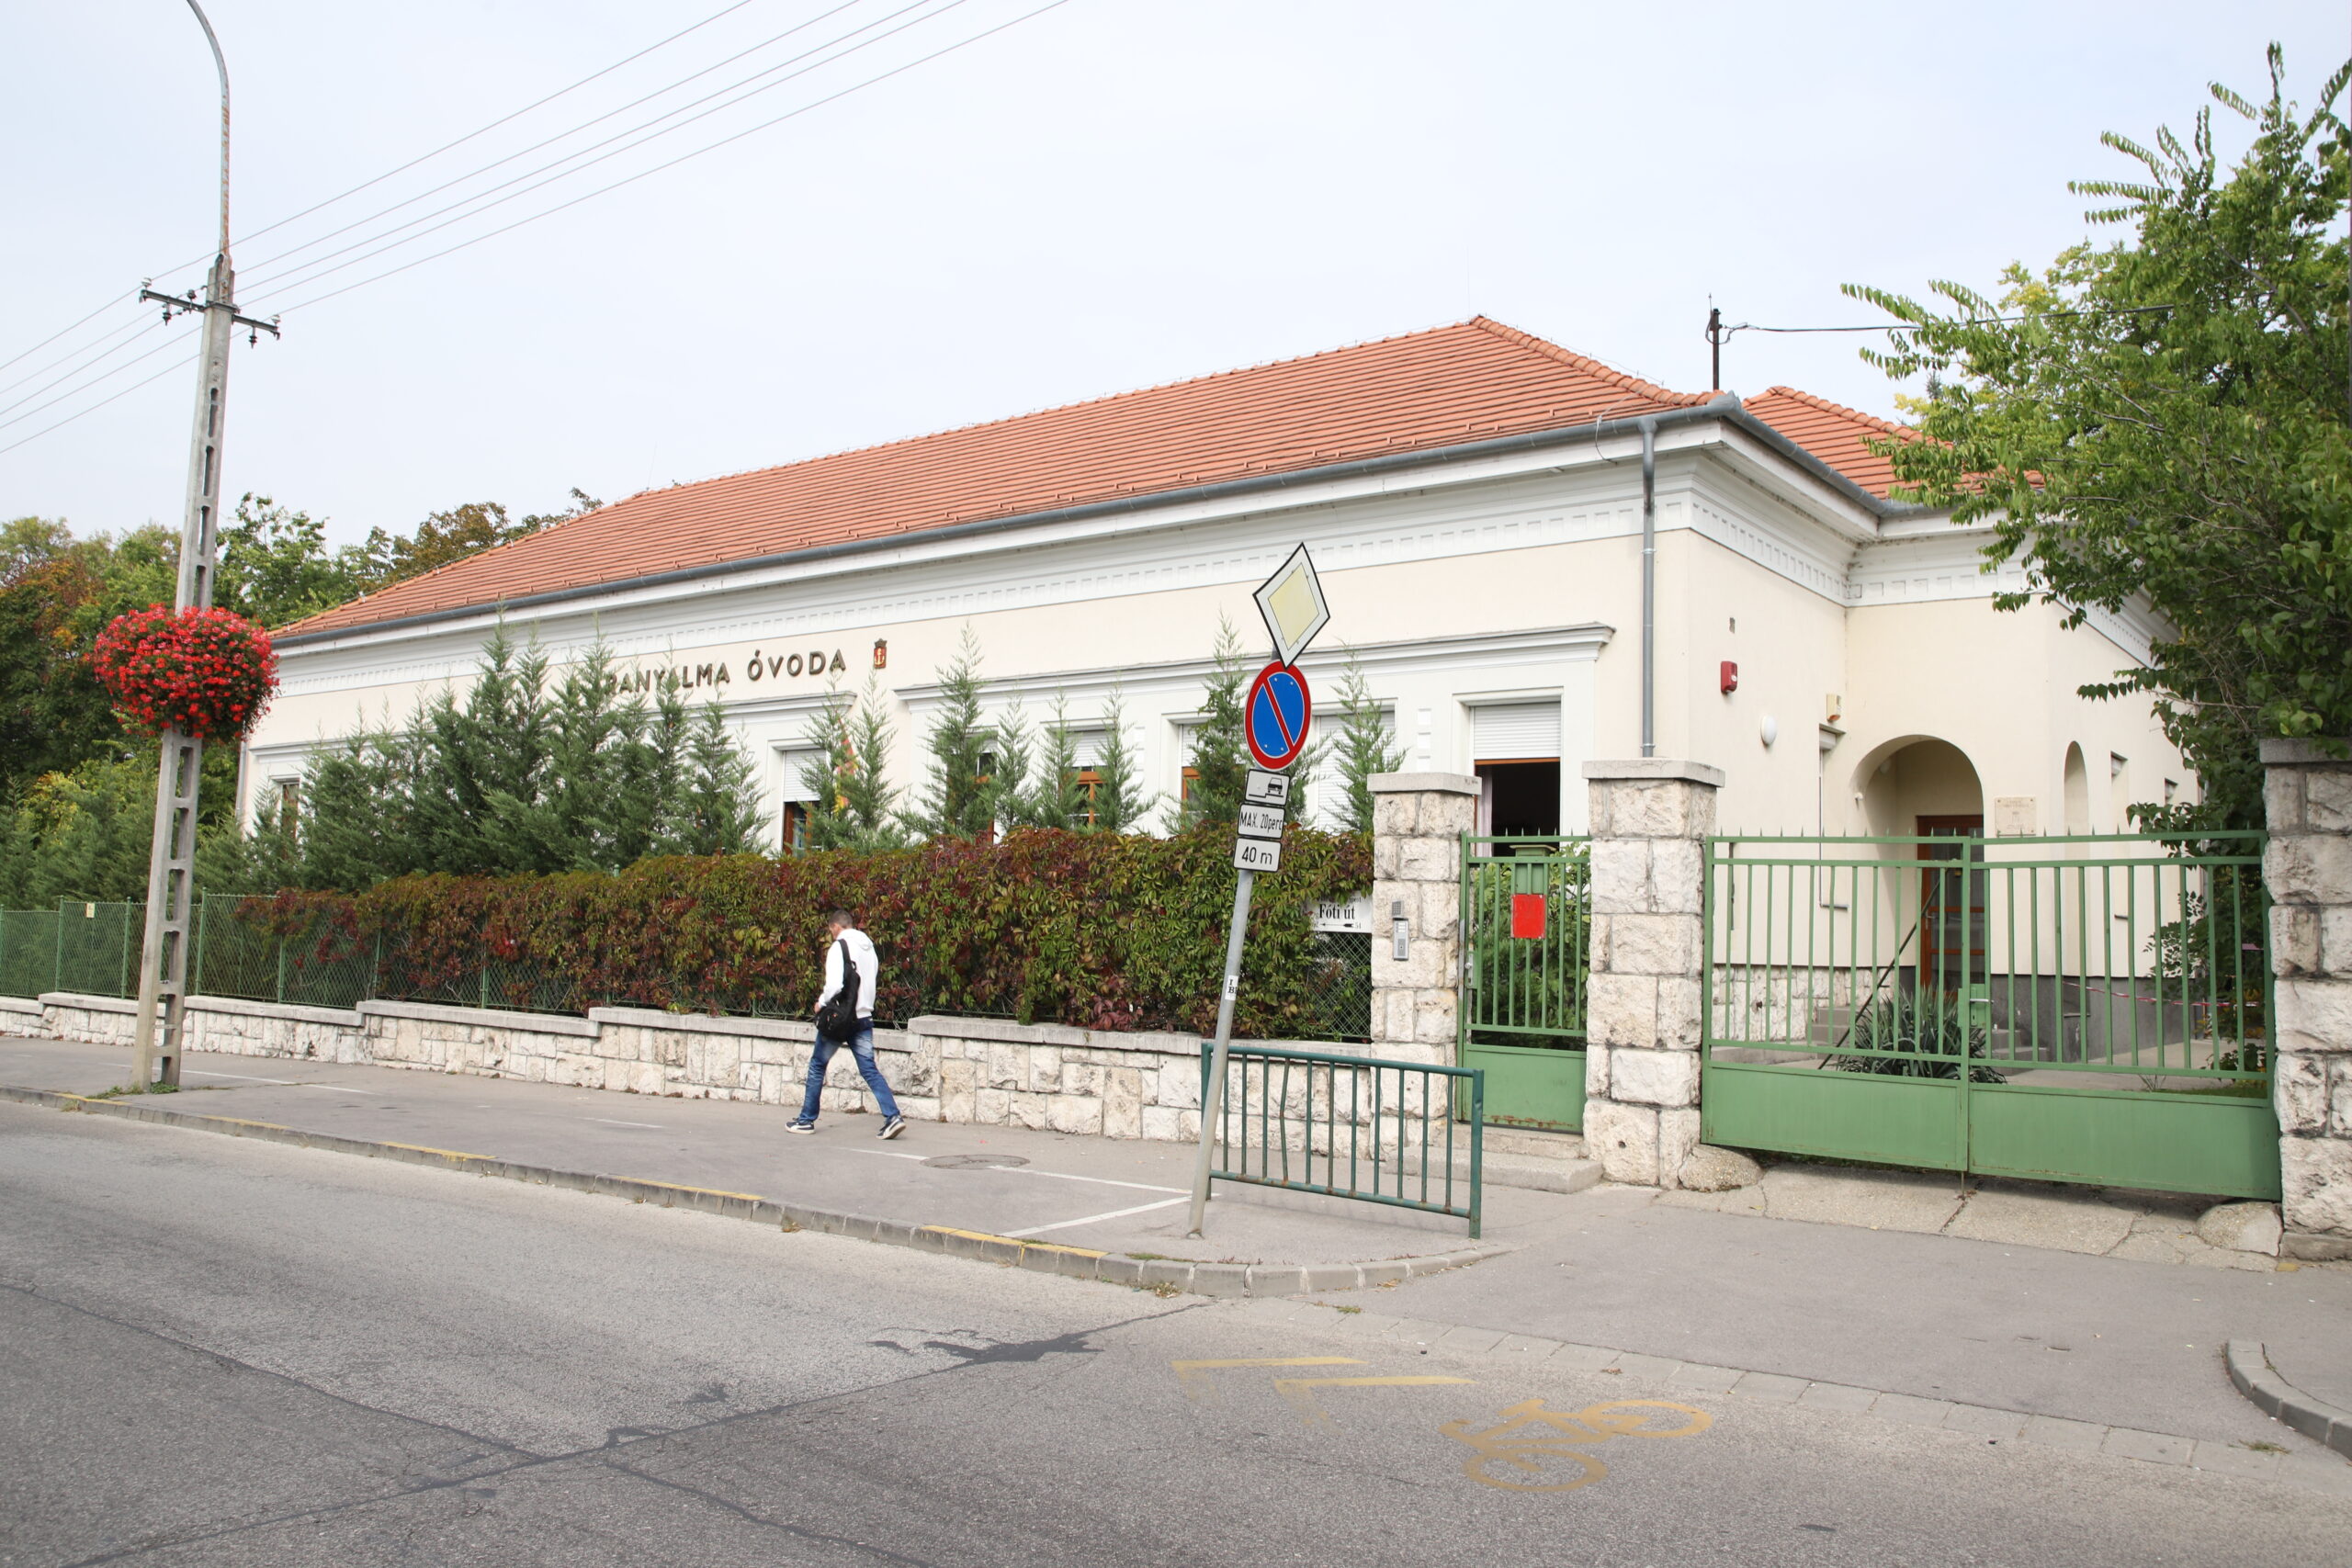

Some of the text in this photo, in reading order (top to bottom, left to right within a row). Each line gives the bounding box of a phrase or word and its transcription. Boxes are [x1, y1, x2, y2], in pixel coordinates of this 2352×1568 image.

[591, 649, 846, 696] RANYLMA ÓVODA
[1239, 811, 1283, 834] MAX. 20perc
[1241, 845, 1272, 865] 40 m
[1319, 903, 1355, 919] Fóti út
